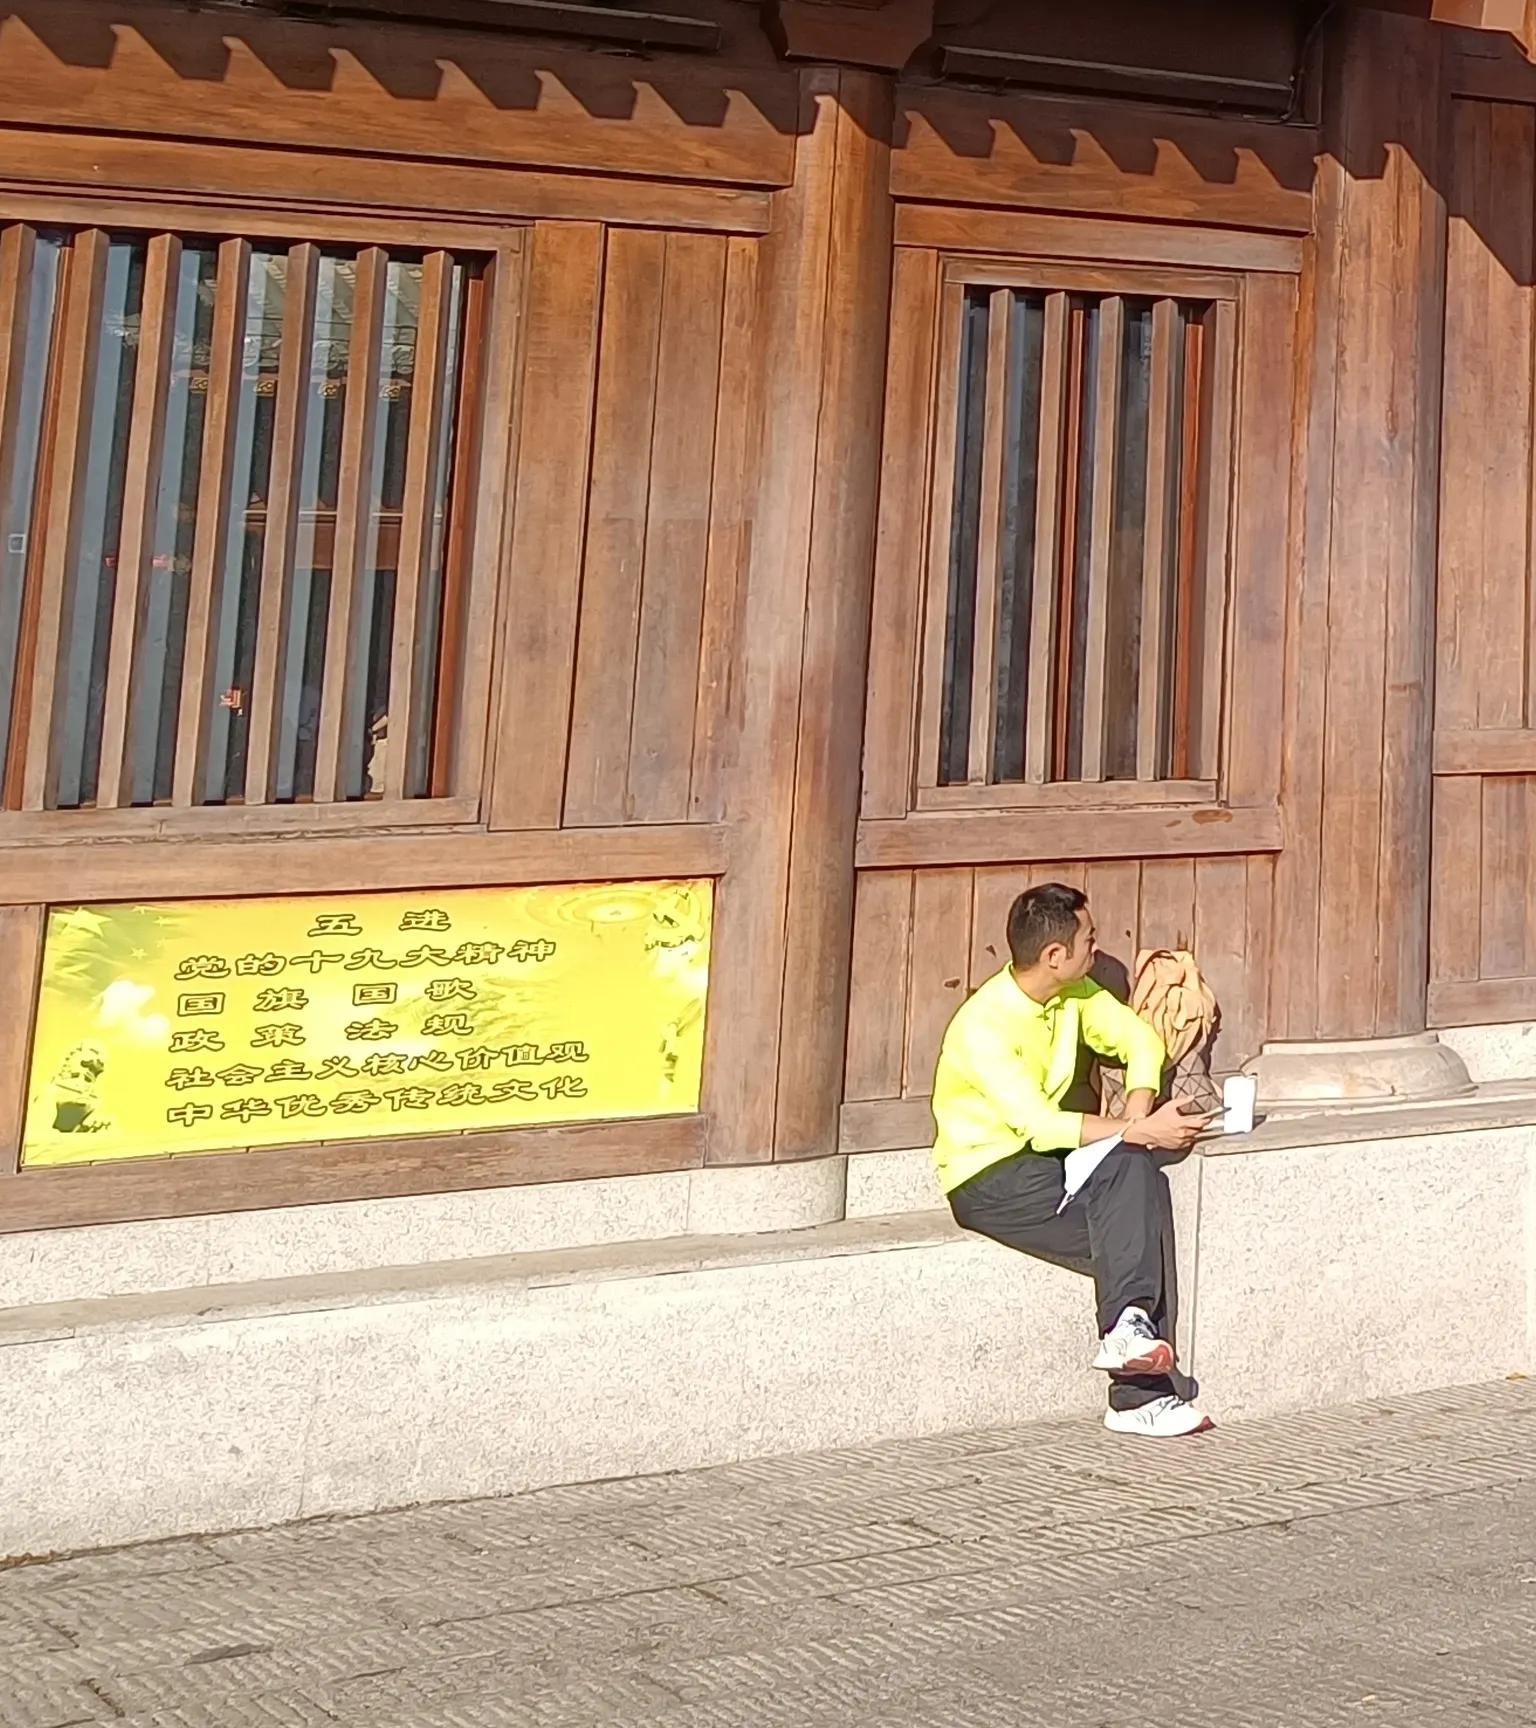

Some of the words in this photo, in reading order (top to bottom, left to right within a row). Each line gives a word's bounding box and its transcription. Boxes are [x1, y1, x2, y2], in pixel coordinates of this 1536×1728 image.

[174, 939, 556, 980] 党的十九大精神
[165, 1041, 589, 1091] 社会主义核心价值观
[167, 1075, 588, 1127] 中华优秀传统文化
